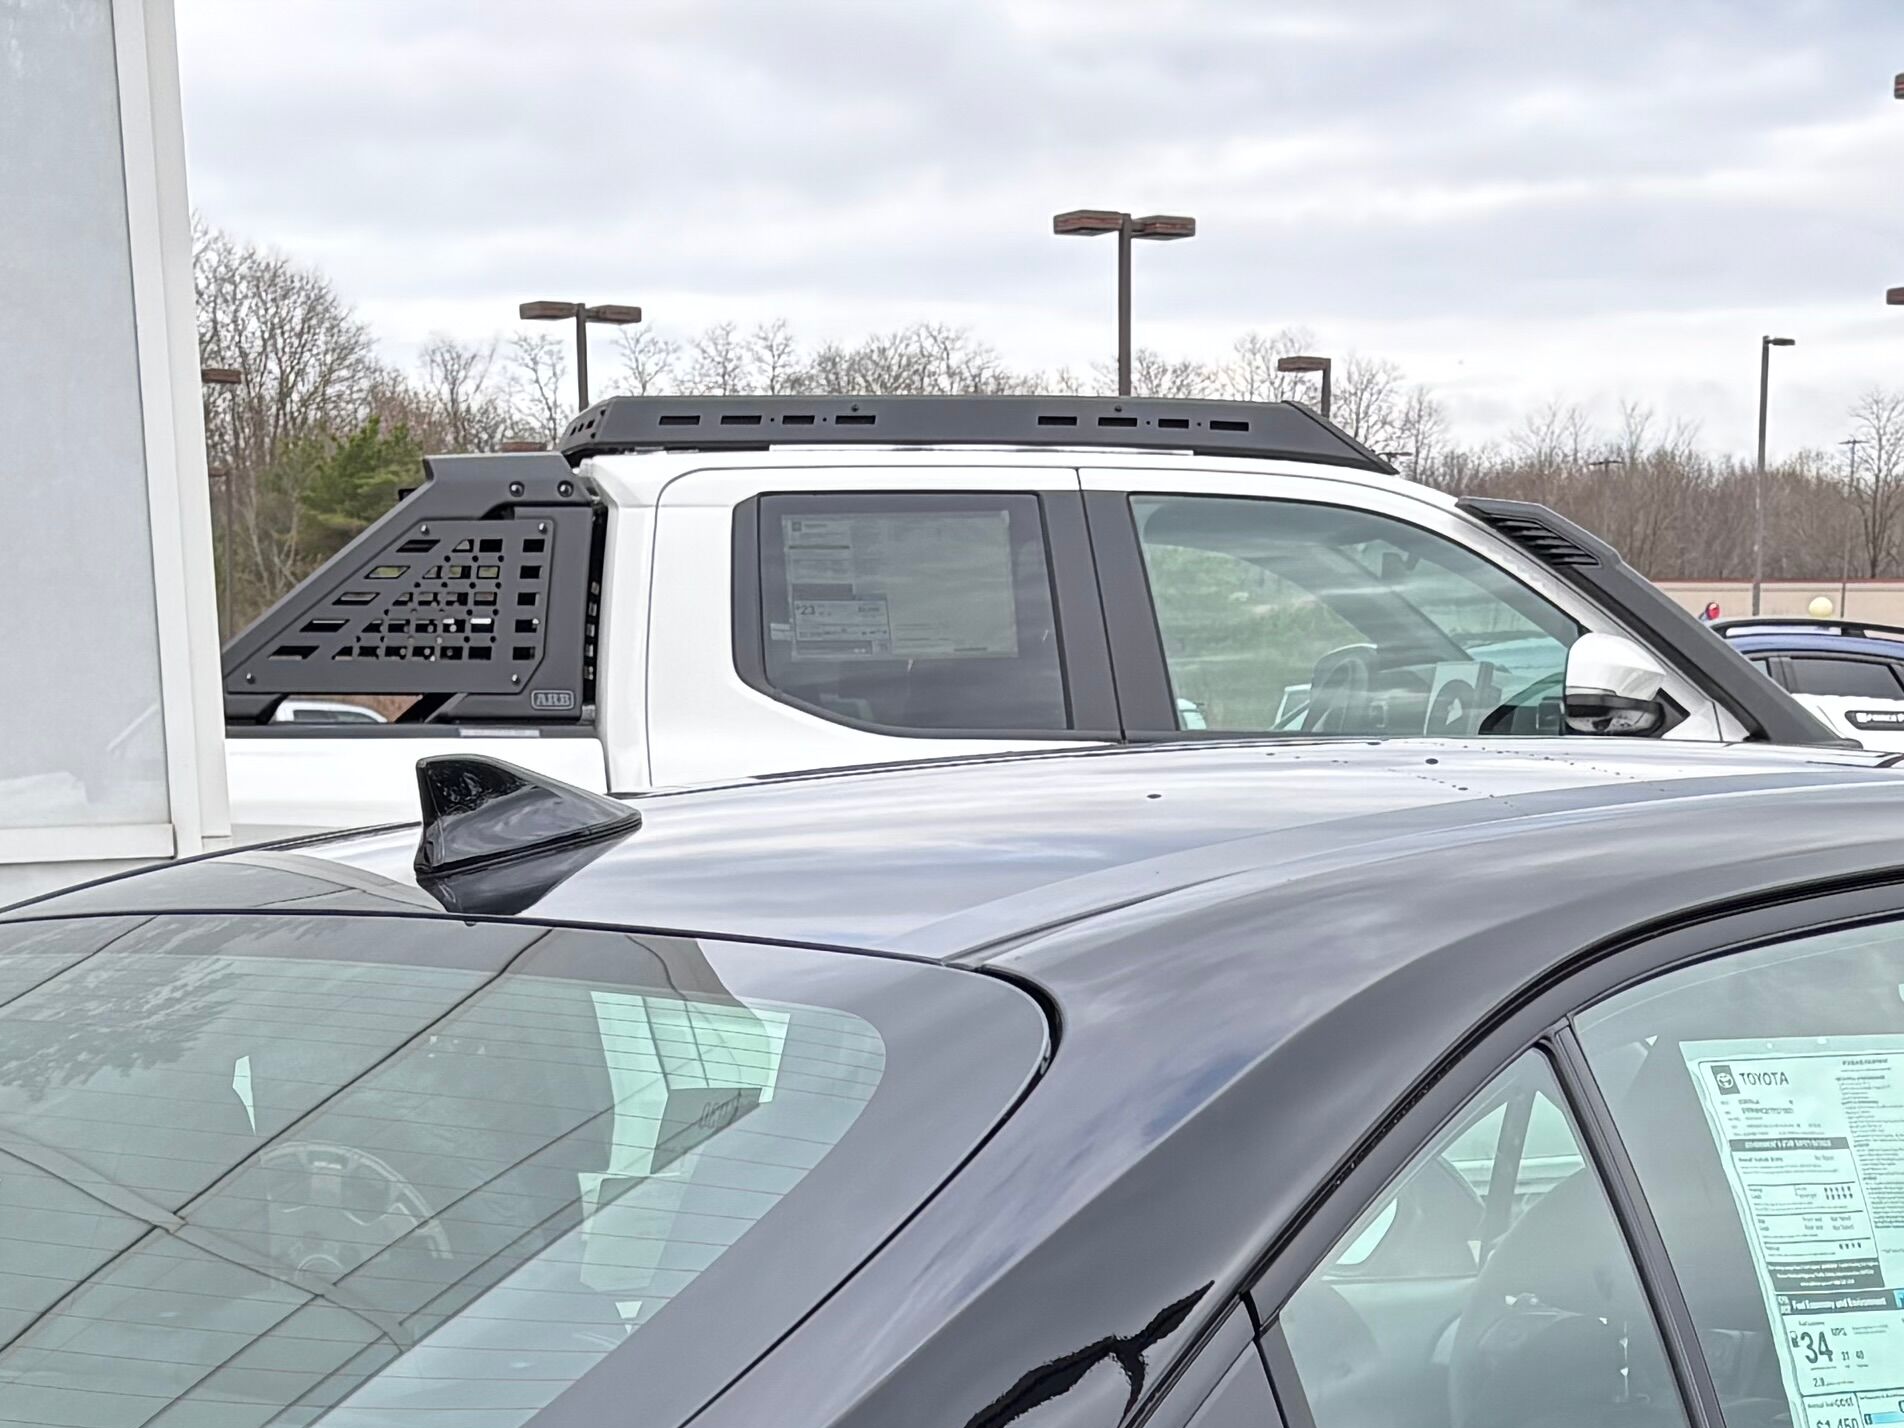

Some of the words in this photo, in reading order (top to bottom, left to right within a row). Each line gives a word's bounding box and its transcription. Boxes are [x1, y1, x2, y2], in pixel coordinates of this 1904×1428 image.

[536, 693, 570, 706] ARB
[1739, 1071, 1789, 1087] TOYOTA
[1800, 1331, 1833, 1363] 34
